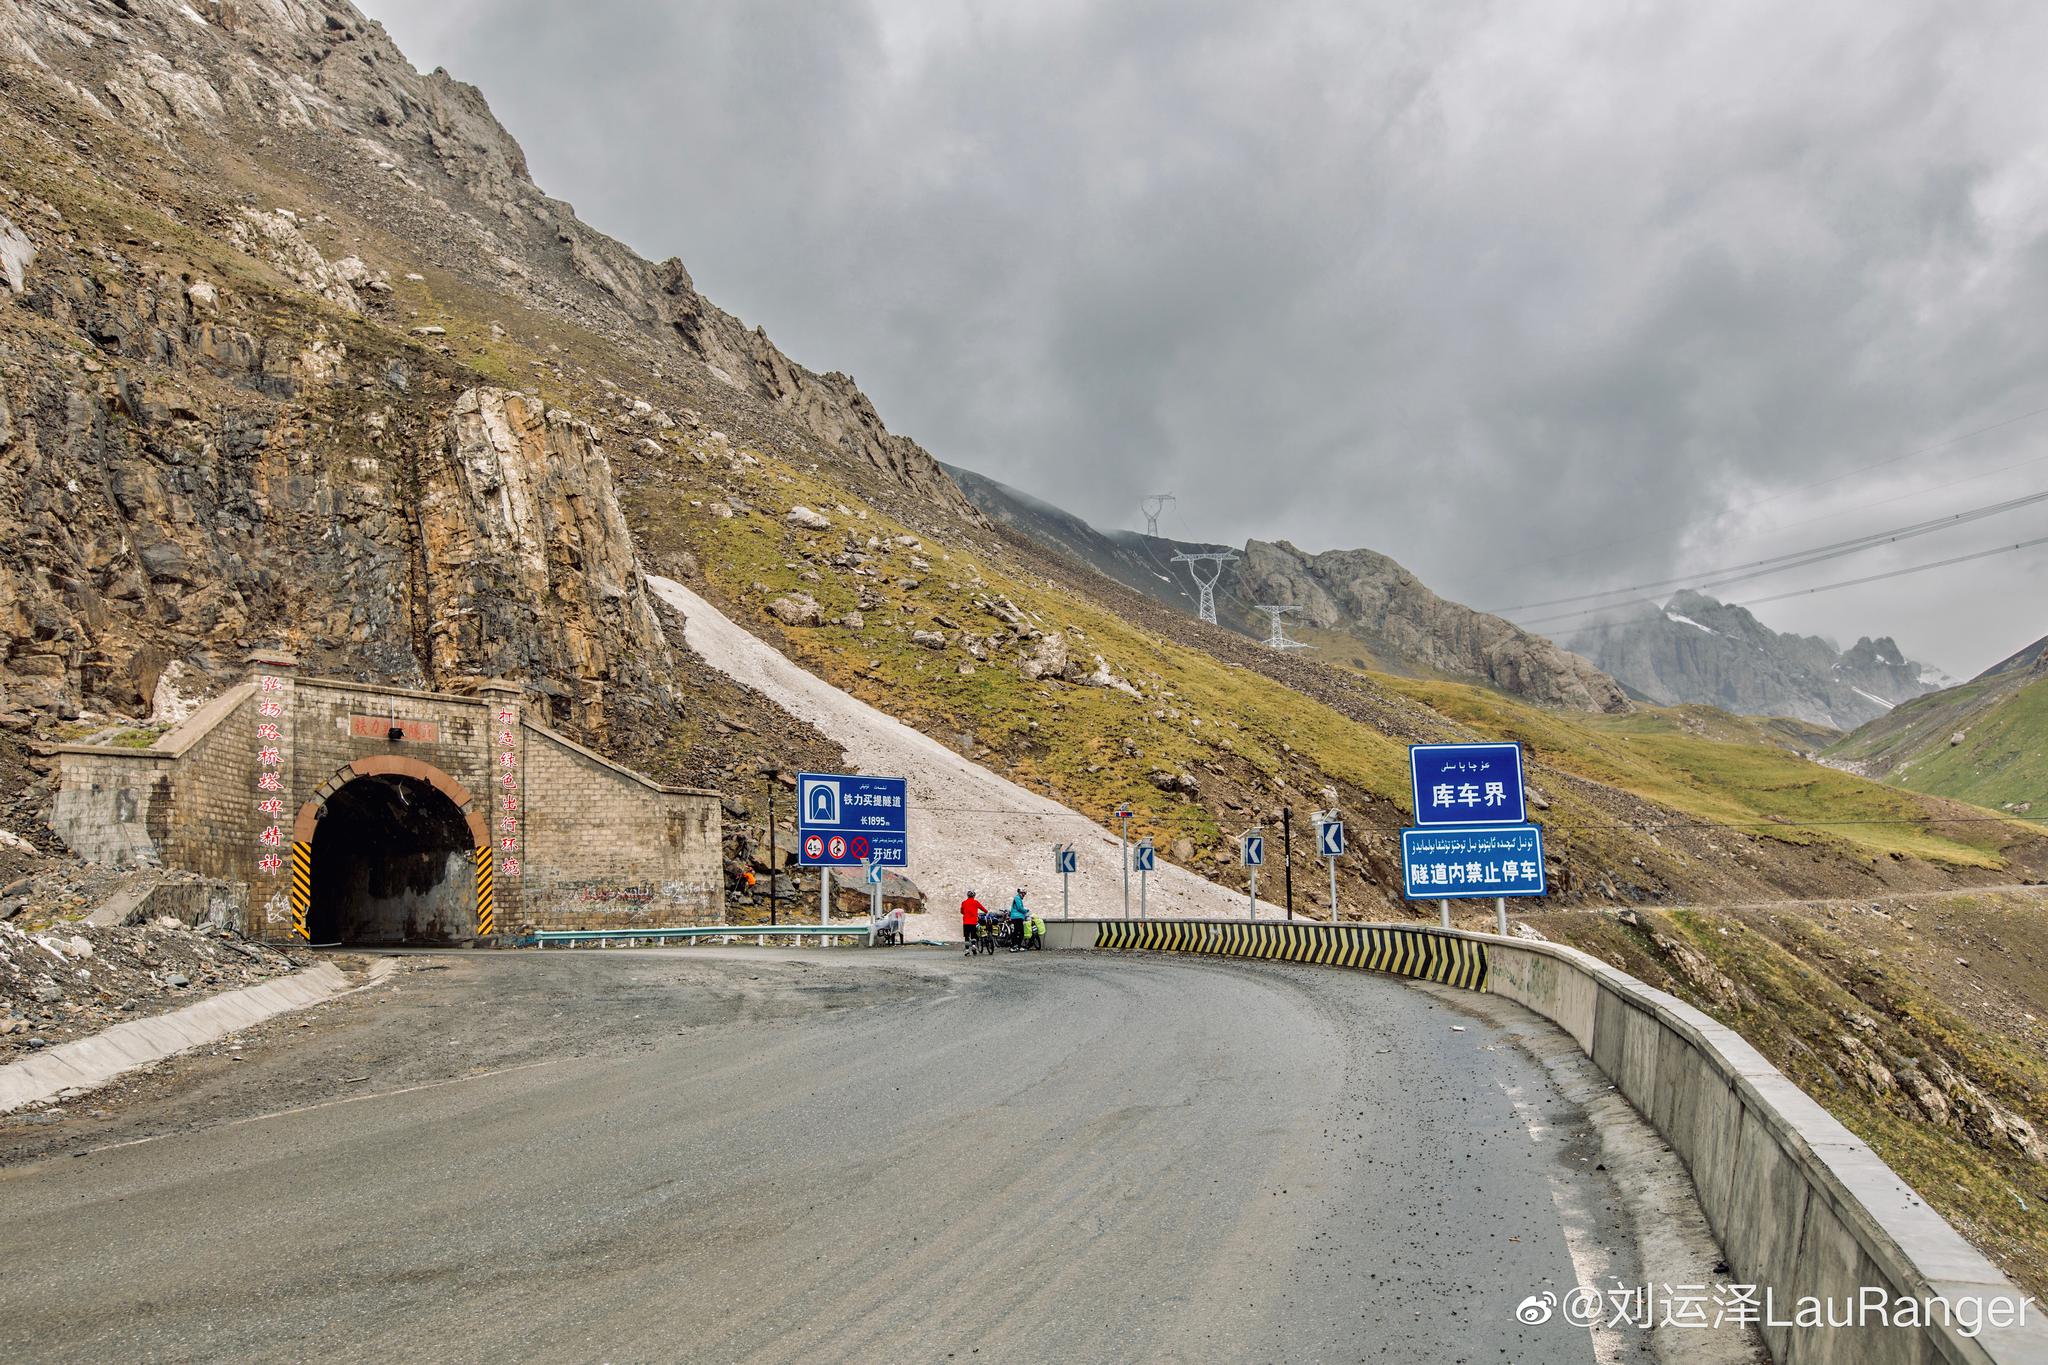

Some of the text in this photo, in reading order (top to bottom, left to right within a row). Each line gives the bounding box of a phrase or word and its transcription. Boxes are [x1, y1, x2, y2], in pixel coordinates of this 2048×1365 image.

[257, 676, 283, 875] 弘扬路桥塔碑精神
[499, 707, 520, 876] 打造绿色出行环境
[844, 794, 901, 807] 铁力买提隧道
[1432, 781, 1507, 808] 库车界
[873, 847, 902, 861] 开近灯
[1411, 860, 1537, 885] 隧道内禁止停车
